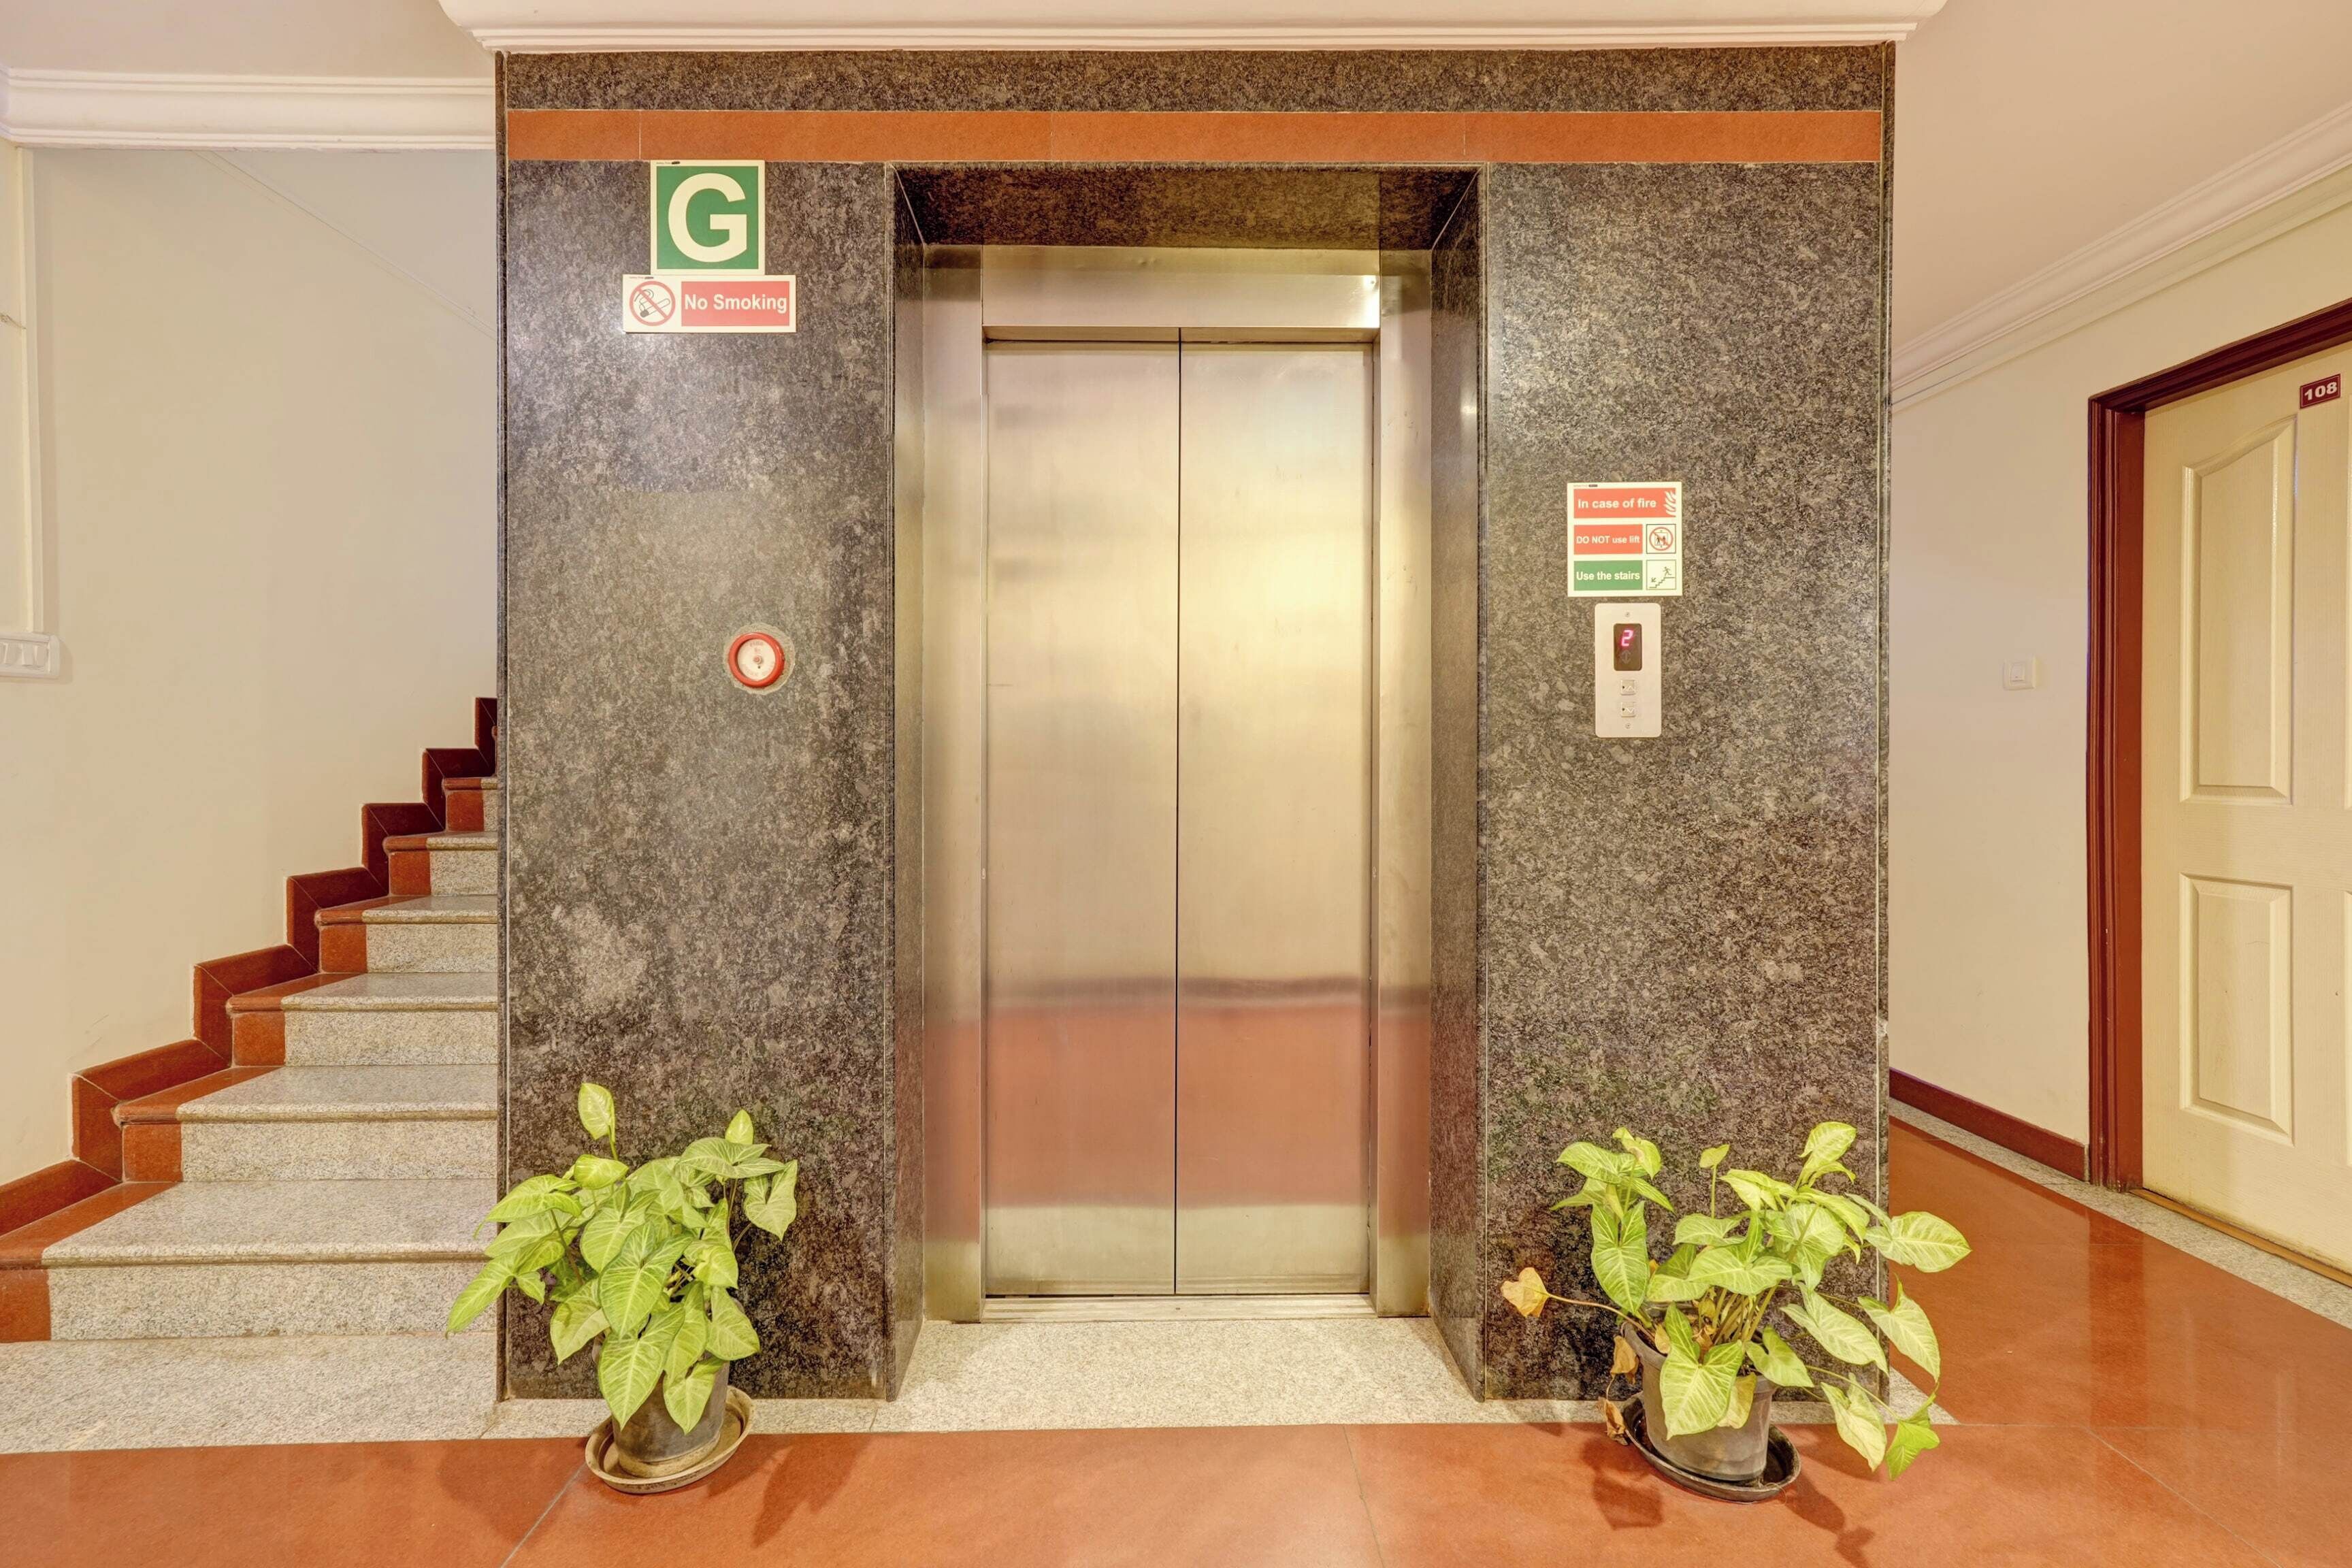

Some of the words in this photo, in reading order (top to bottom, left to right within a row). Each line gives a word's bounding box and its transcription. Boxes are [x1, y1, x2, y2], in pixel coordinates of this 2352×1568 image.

[668, 173, 747, 263] G
[684, 294, 708, 310] No
[713, 293, 787, 314] Smoking
[2304, 381, 2338, 401] 108
[1578, 499, 1589, 508] In
[1592, 500, 1619, 508] case
[1622, 498, 1635, 508] of
[1637, 497, 1656, 508] fire
[1576, 536, 1590, 544] DO
[1592, 536, 1610, 544] NOT
[1629, 535, 1640, 544] lift
[1576, 571, 1595, 581] Use
[1597, 571, 1612, 581] the
[1614, 570, 1640, 581] stairs
[1621, 630, 1634, 647] 2
